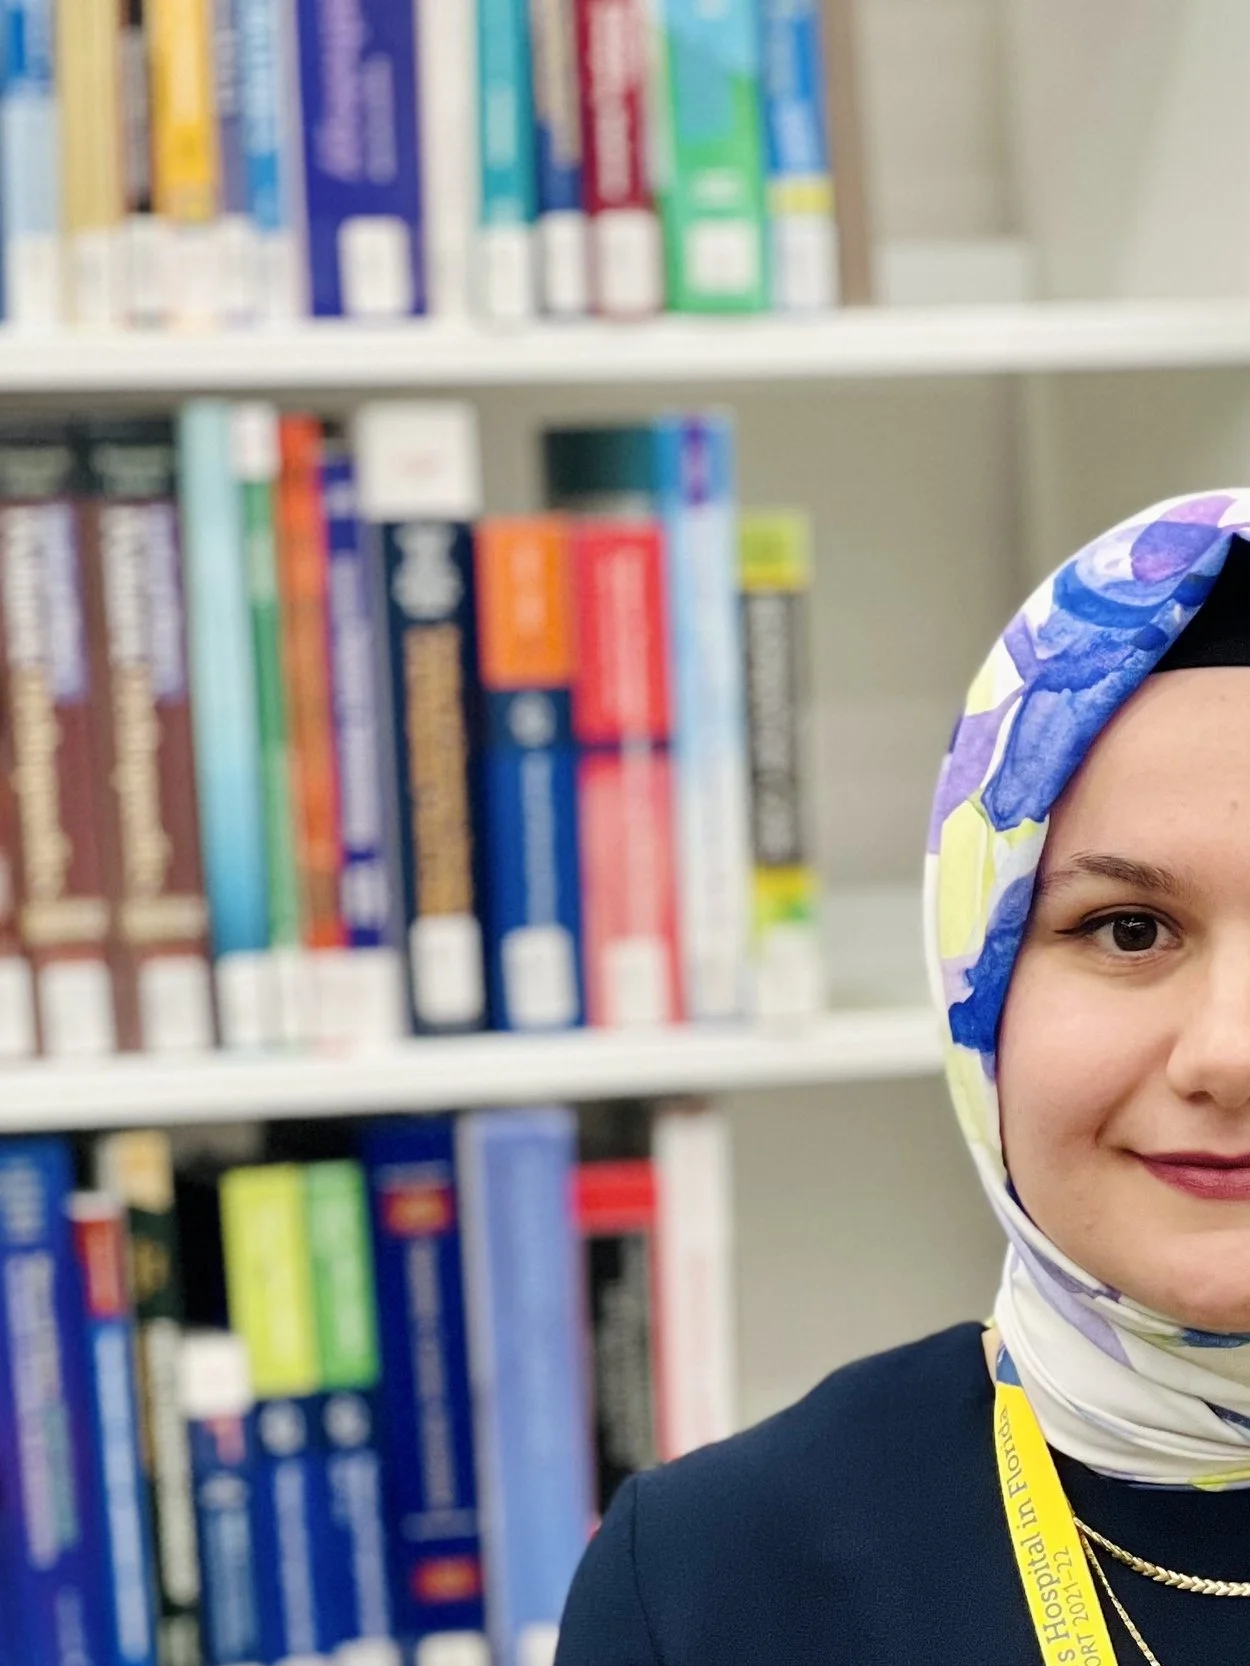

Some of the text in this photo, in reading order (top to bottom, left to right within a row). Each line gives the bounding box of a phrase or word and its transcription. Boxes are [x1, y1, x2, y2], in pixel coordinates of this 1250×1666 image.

[998, 1404, 1027, 1498] Florida
[1016, 1498, 1038, 1529] in
[1020, 1531, 1070, 1644] Hospital
